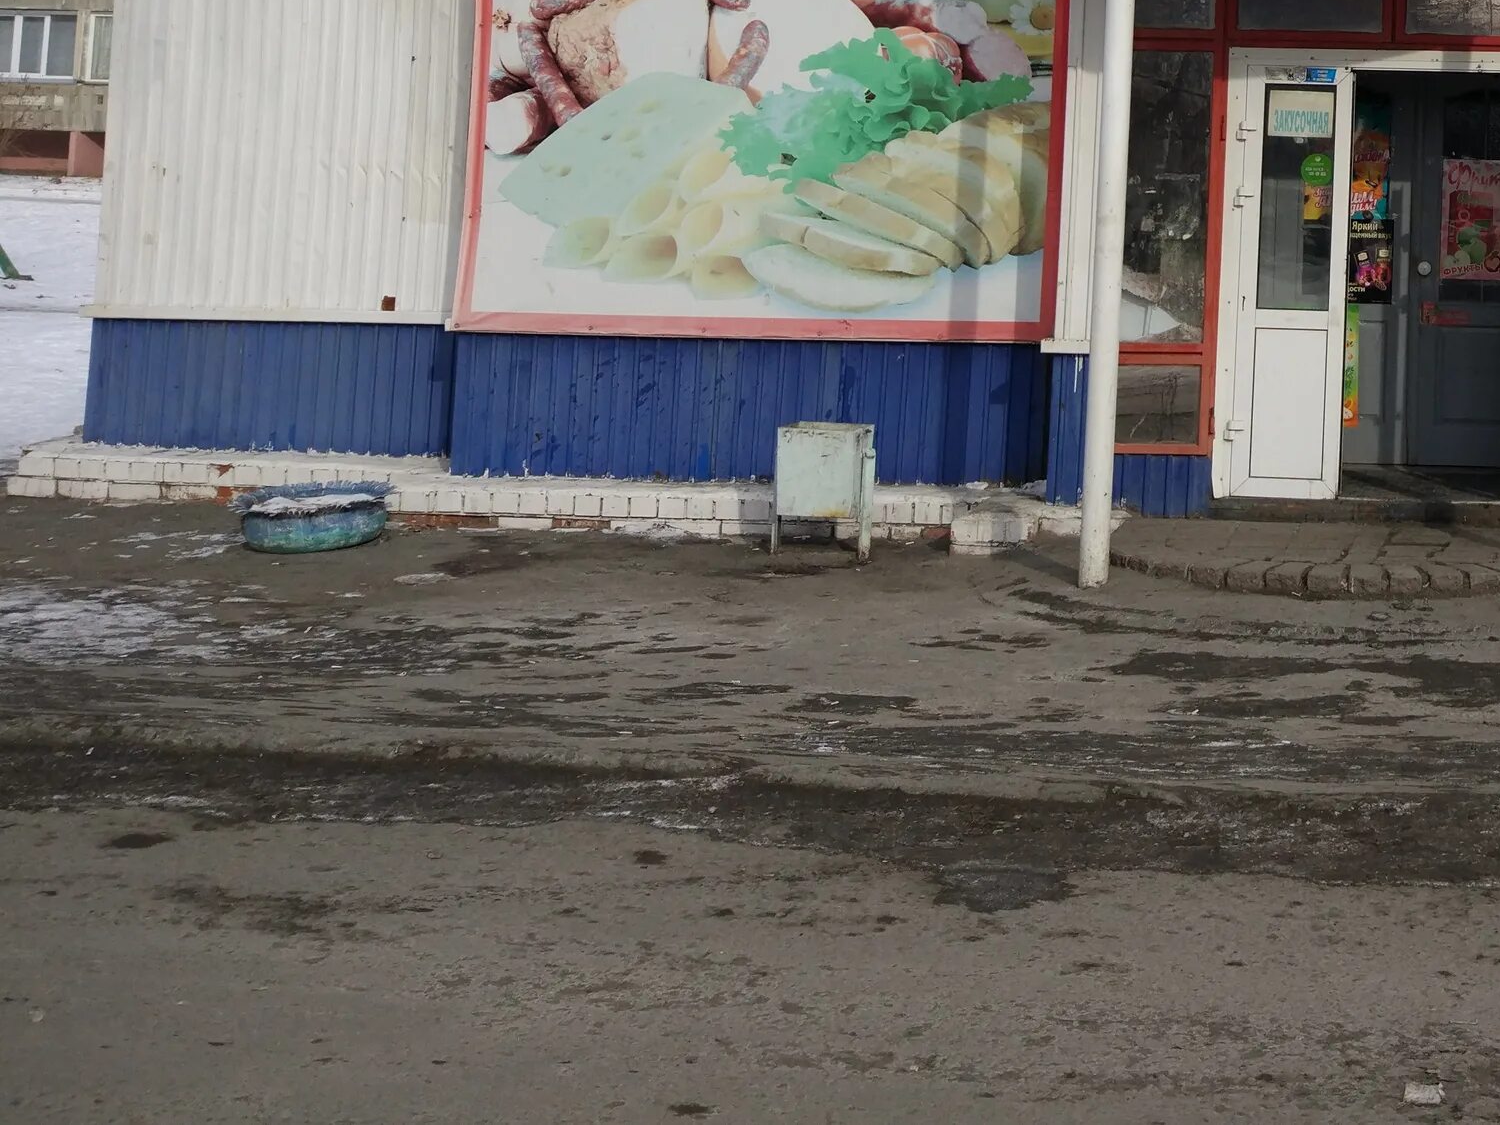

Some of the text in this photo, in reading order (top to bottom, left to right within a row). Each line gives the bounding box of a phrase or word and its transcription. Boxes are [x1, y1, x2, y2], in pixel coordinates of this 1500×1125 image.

[1274, 109, 1329, 133] ЗАКУСОЧНАЯ
[1352, 221, 1378, 231] Яркий
[1443, 264, 1484, 275] ФРУКТЫ
